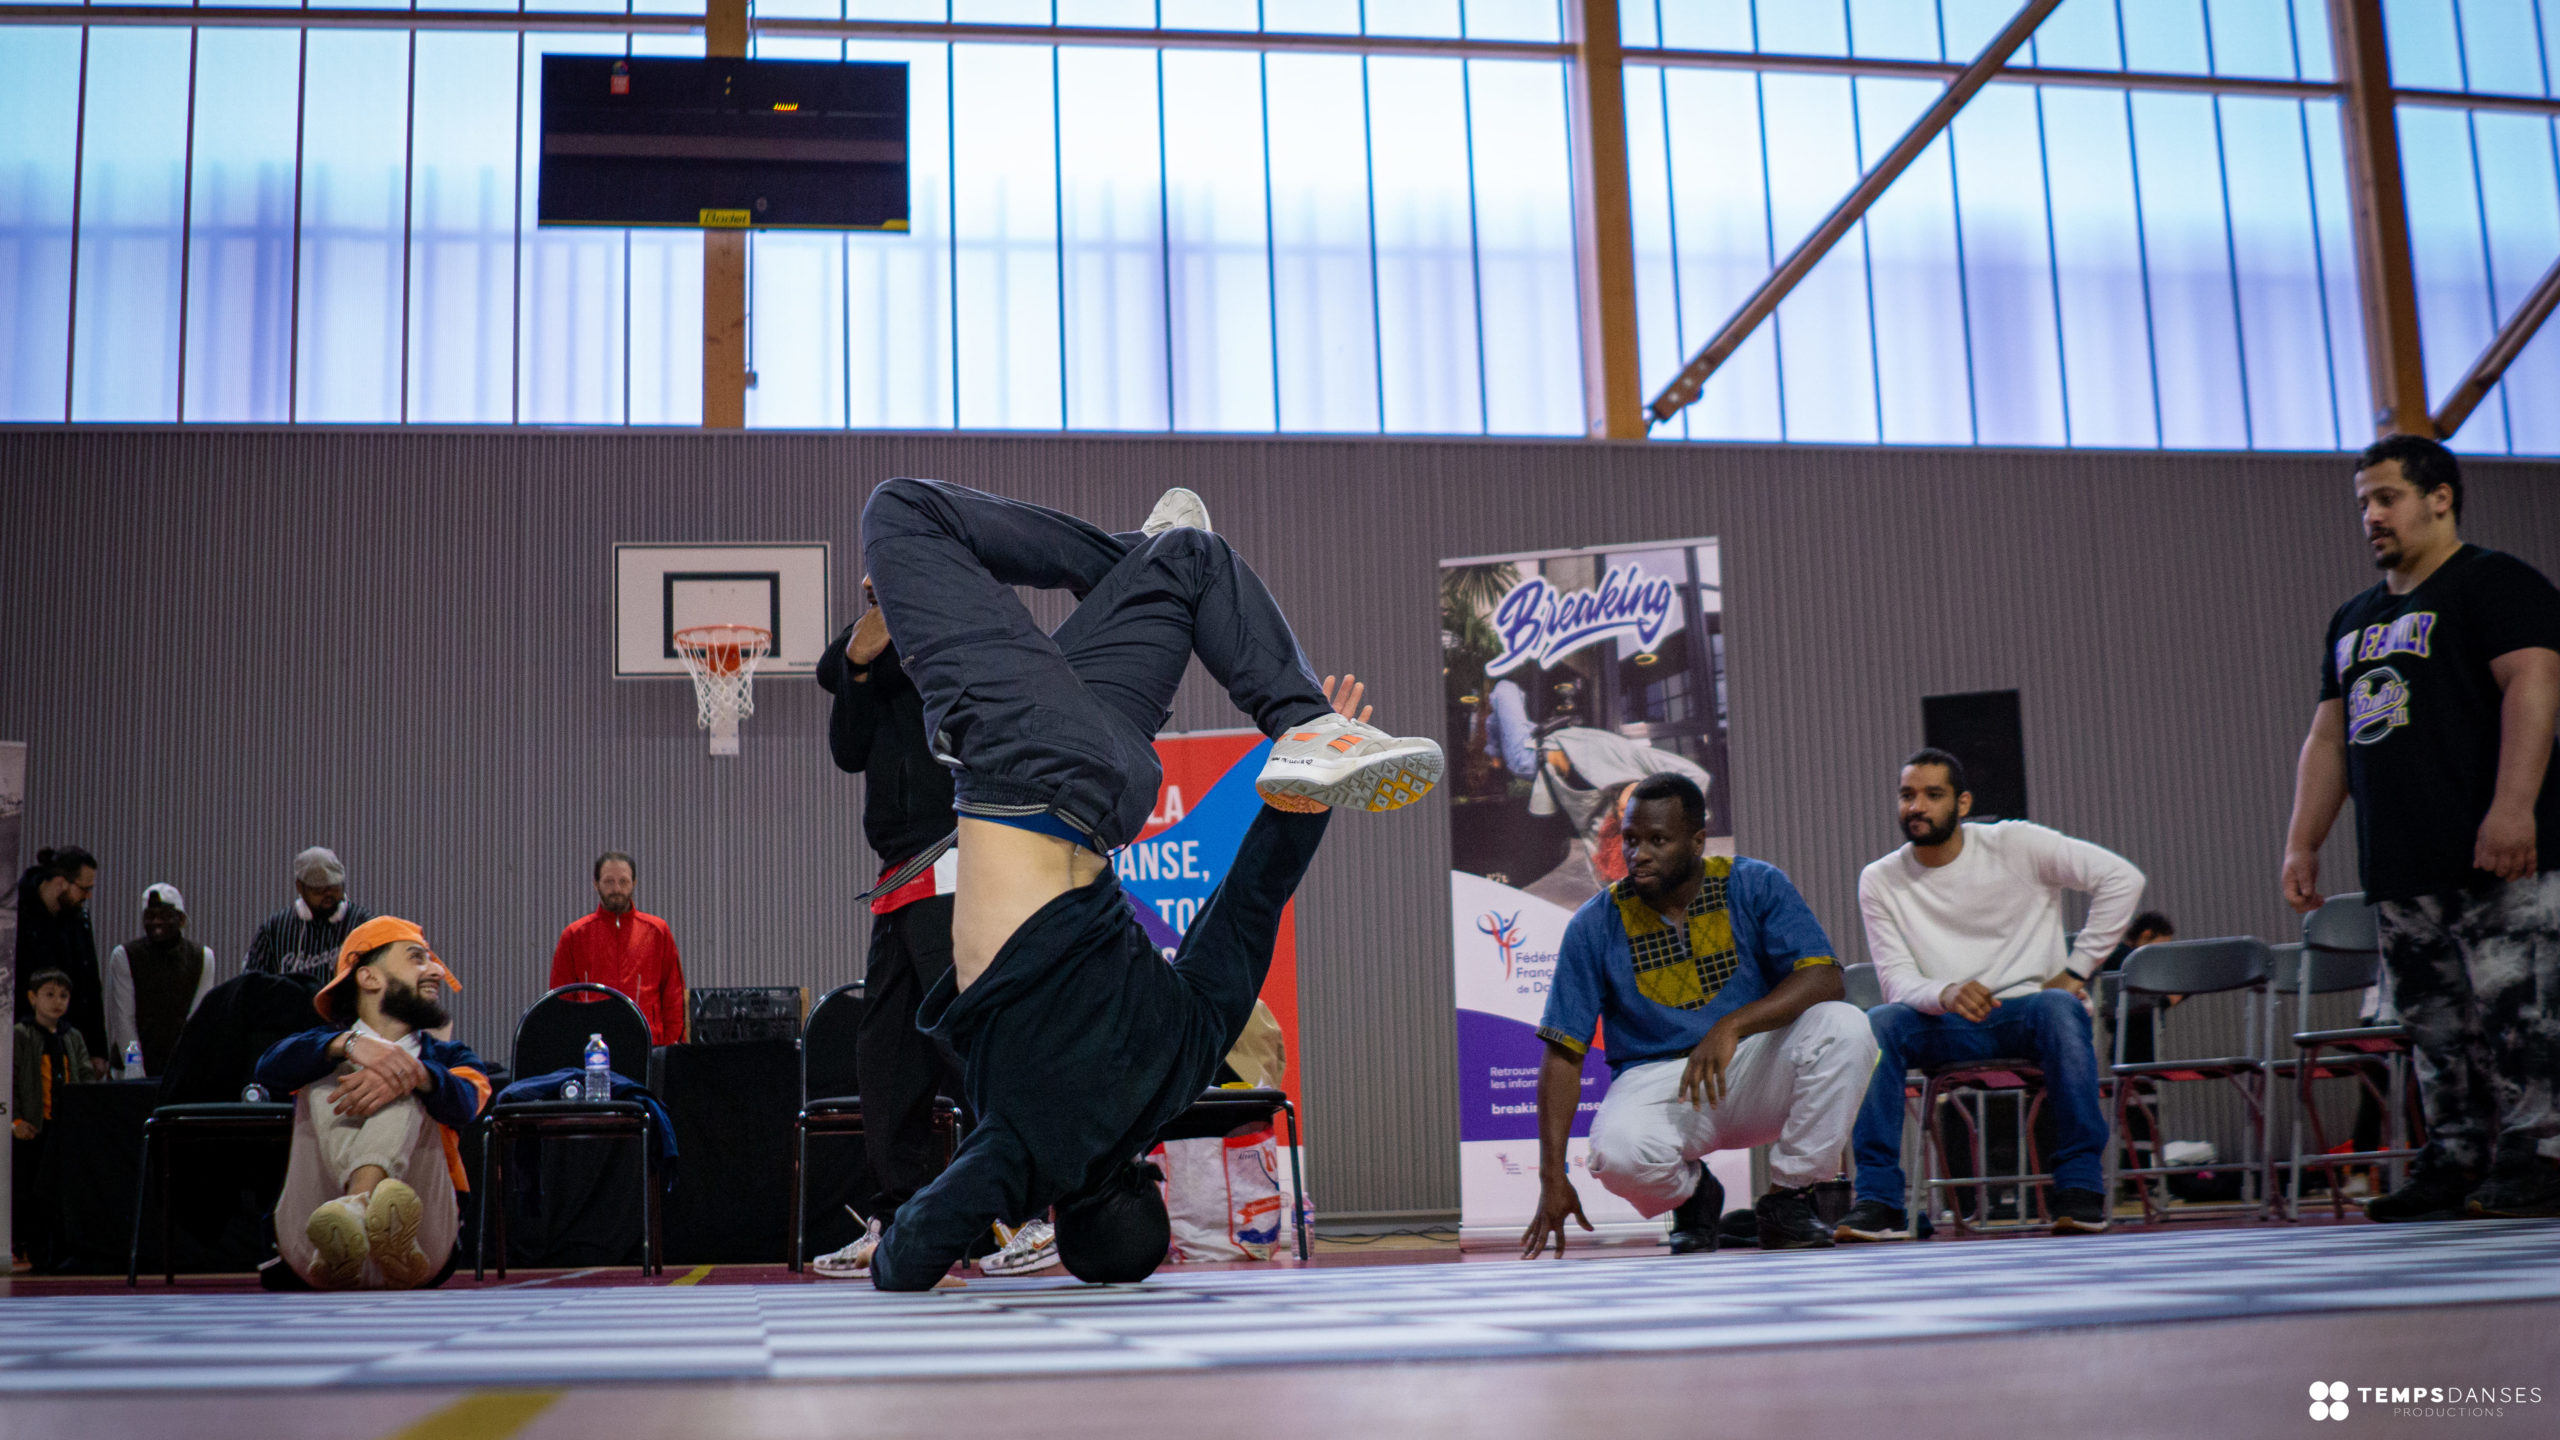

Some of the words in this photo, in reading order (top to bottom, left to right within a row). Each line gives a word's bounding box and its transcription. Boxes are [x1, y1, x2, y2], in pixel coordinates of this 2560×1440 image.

[1488, 564, 1673, 670] Breaking
[1156, 898, 1204, 936] TO
[1517, 985, 1529, 993] de
[1491, 1080, 1505, 1088] les
